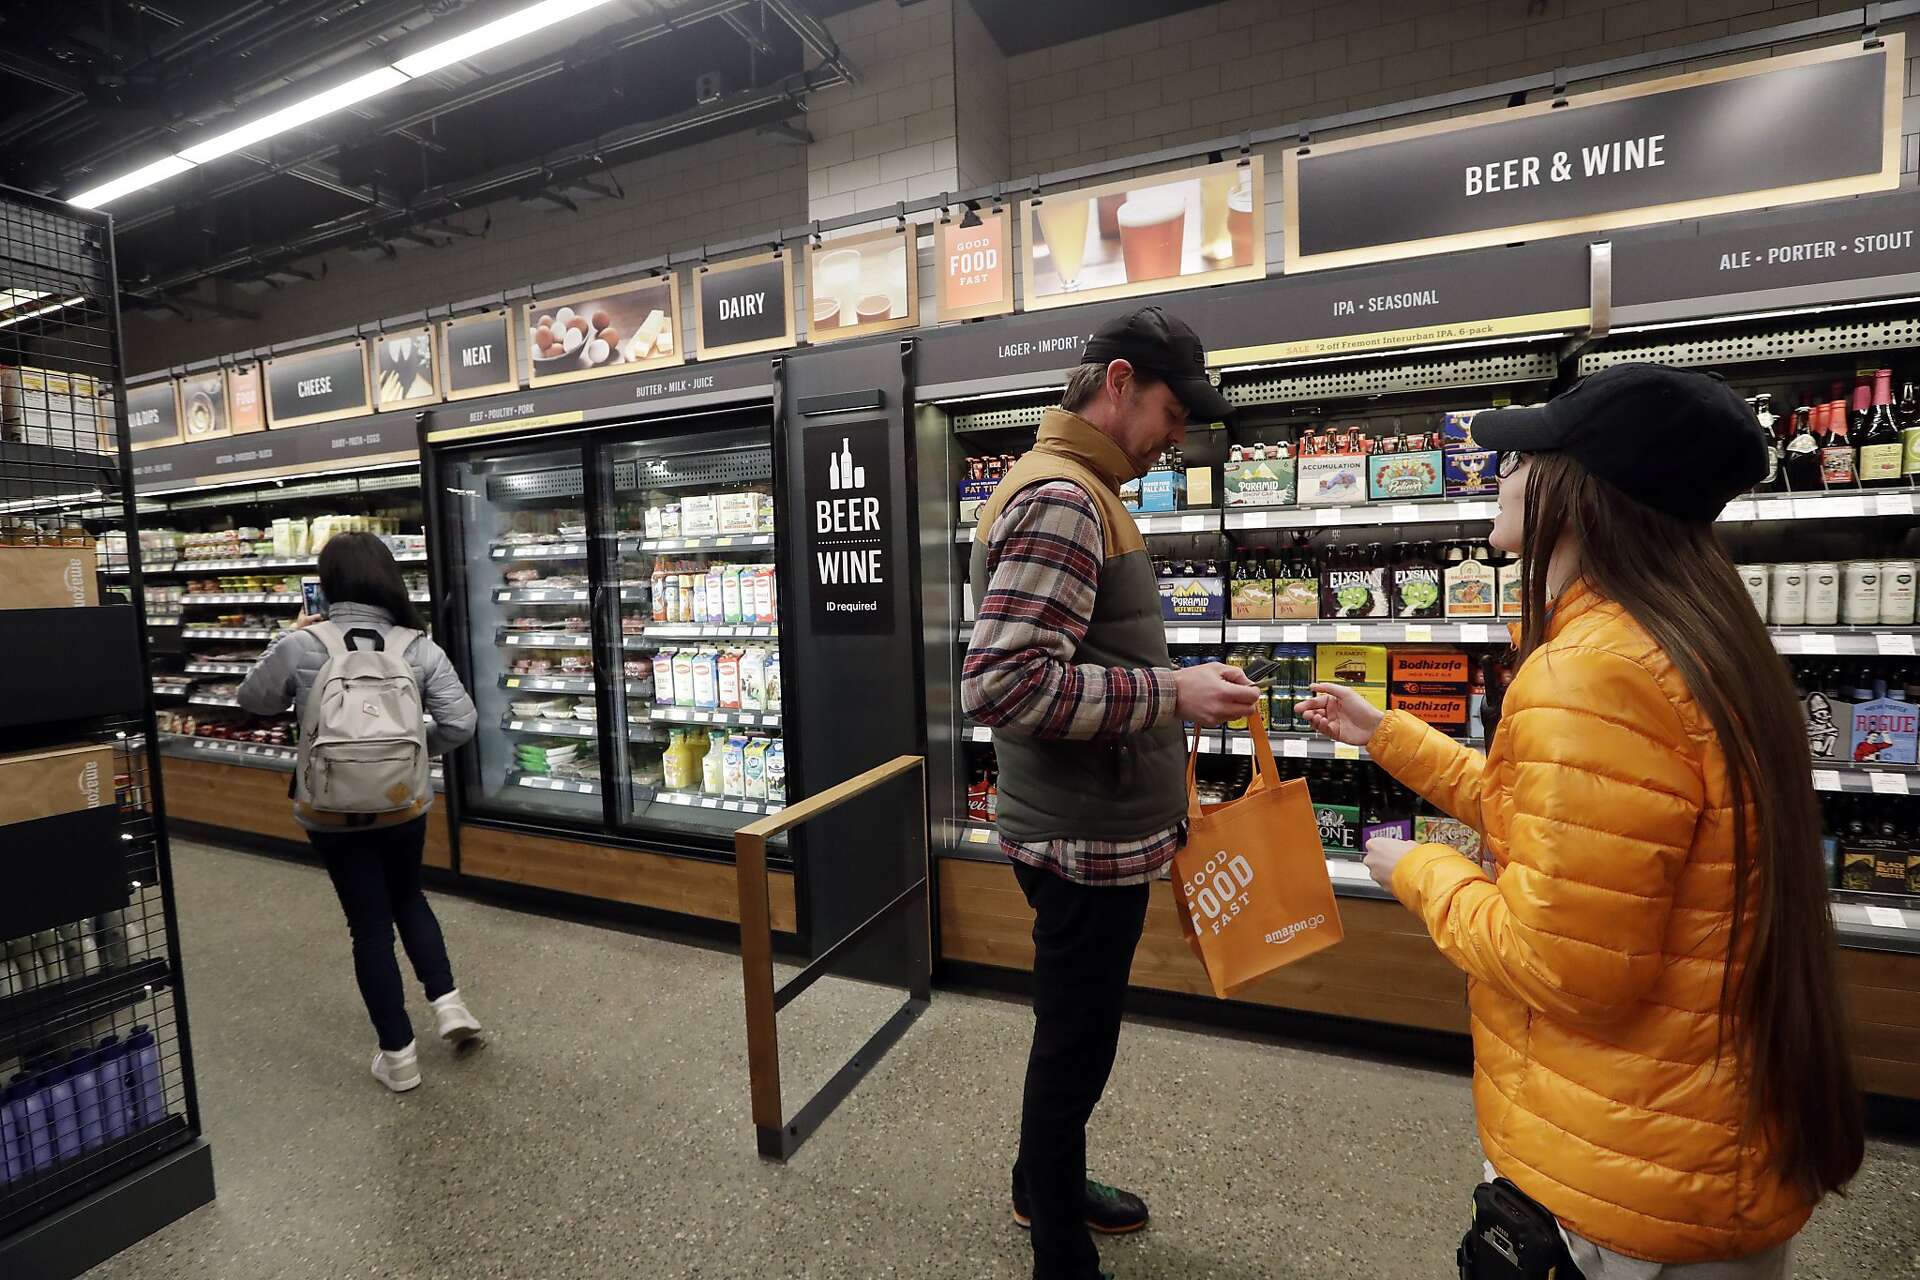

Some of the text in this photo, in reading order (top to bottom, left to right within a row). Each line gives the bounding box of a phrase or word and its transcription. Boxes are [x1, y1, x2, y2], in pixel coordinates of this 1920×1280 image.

[1465, 134, 1665, 197] BEER & WINE
[956, 238, 990, 251] GOOD
[1719, 230, 1914, 271] ALE PORTER STOUT
[950, 249, 998, 276] FOOD
[959, 274, 989, 286] FAST
[719, 292, 765, 321] DAIRY
[1333, 289, 1440, 316] IPA SEASONAL
[998, 342, 1030, 358] LAGER
[1038, 335, 1079, 353] IMPORT
[1287, 345, 1310, 355] SALE
[1327, 342, 1340, 350] off
[1342, 338, 1380, 349] Fremont
[1383, 332, 1435, 344] Interurban
[1459, 325, 1494, 336] 6-pack
[462, 344, 492, 367] MEAT
[297, 375, 333, 398] CHEESE
[636, 376, 714, 397] BUTTER MILK JUICE
[469, 403, 535, 422] BEEF POULTRY PORK
[1302, 462, 1361, 470] ACCUMULATION
[964, 484, 1000, 494] FAT TIR
[1238, 481, 1279, 491] PYRAMID
[816, 497, 881, 534] BEER
[817, 550, 884, 585] WINE
[1330, 570, 1383, 588] ELYSIAN
[1395, 569, 1439, 584] ELYSIAN
[67, 558, 86, 607] amazon
[826, 601, 877, 612] ID required
[1171, 597, 1209, 607] PYRAMID
[1399, 660, 1462, 671] Bodhizafa
[1397, 700, 1461, 712] Bodhizafa
[1855, 714, 1916, 733] ROGUE
[83, 761, 101, 809] amazon
[1317, 826, 1355, 848] ONE
[1183, 850, 1228, 897] GOOD
[1211, 892, 1250, 936] FAST
[1263, 919, 1308, 944] amazon
